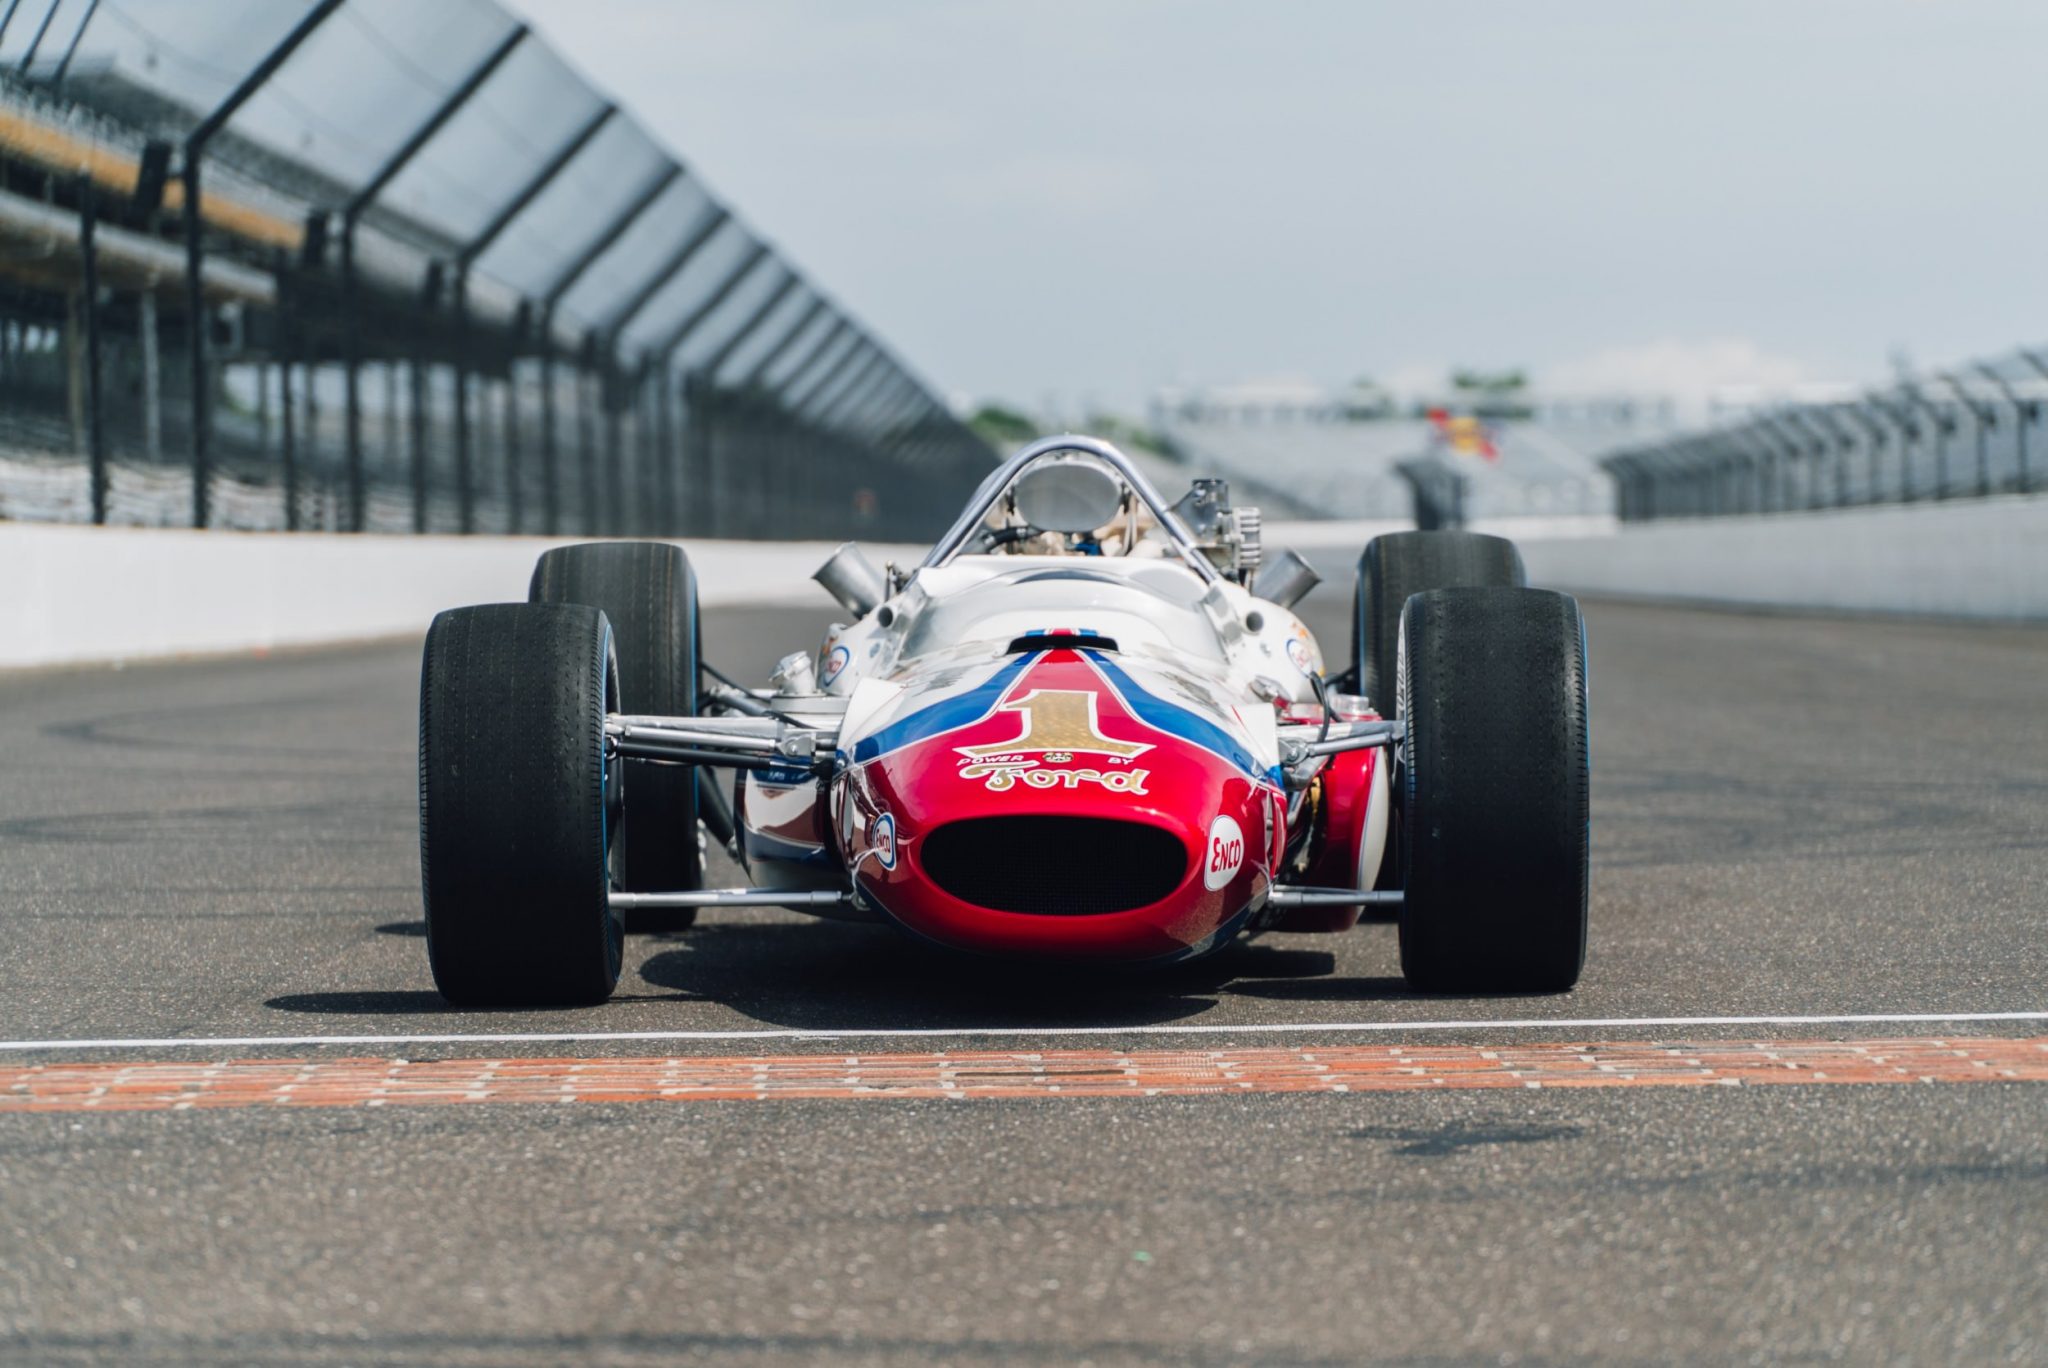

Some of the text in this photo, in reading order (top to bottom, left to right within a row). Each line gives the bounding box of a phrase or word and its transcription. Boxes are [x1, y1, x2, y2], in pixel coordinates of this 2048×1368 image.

[952, 688, 1157, 758] 1
[956, 755, 1134, 767] POWER BY
[959, 760, 1151, 795] Ford
[1211, 837, 1241, 873] ENCO
